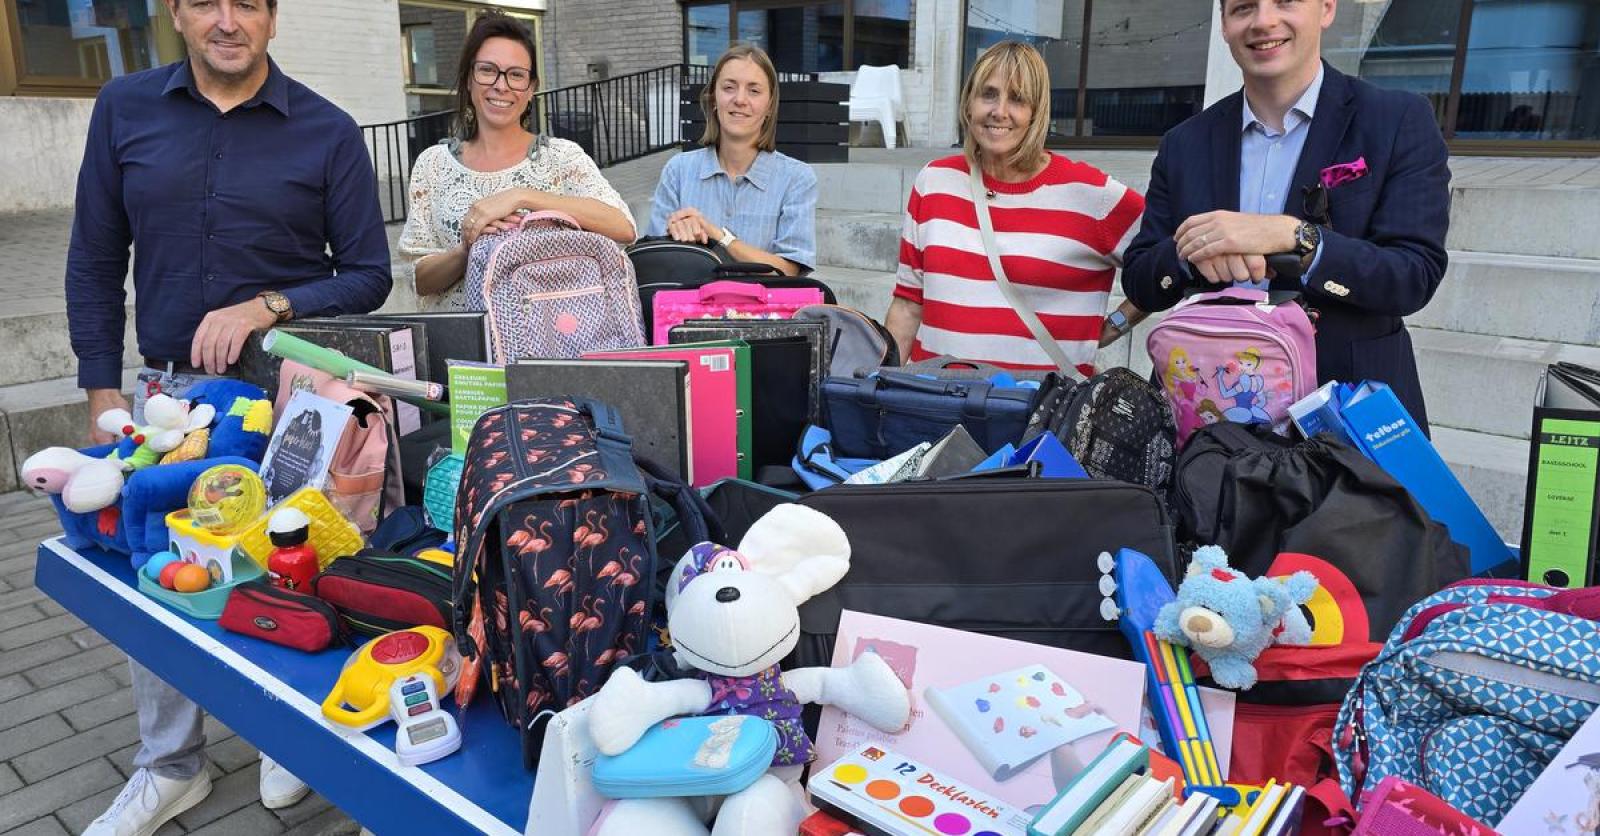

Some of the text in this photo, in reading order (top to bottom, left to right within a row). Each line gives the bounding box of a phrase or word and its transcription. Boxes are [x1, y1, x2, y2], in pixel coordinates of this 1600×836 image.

[1366, 419, 1405, 441] telbox
[1551, 435, 1589, 446] LEITZ
[893, 762, 1000, 819] 12 Deckfarben
